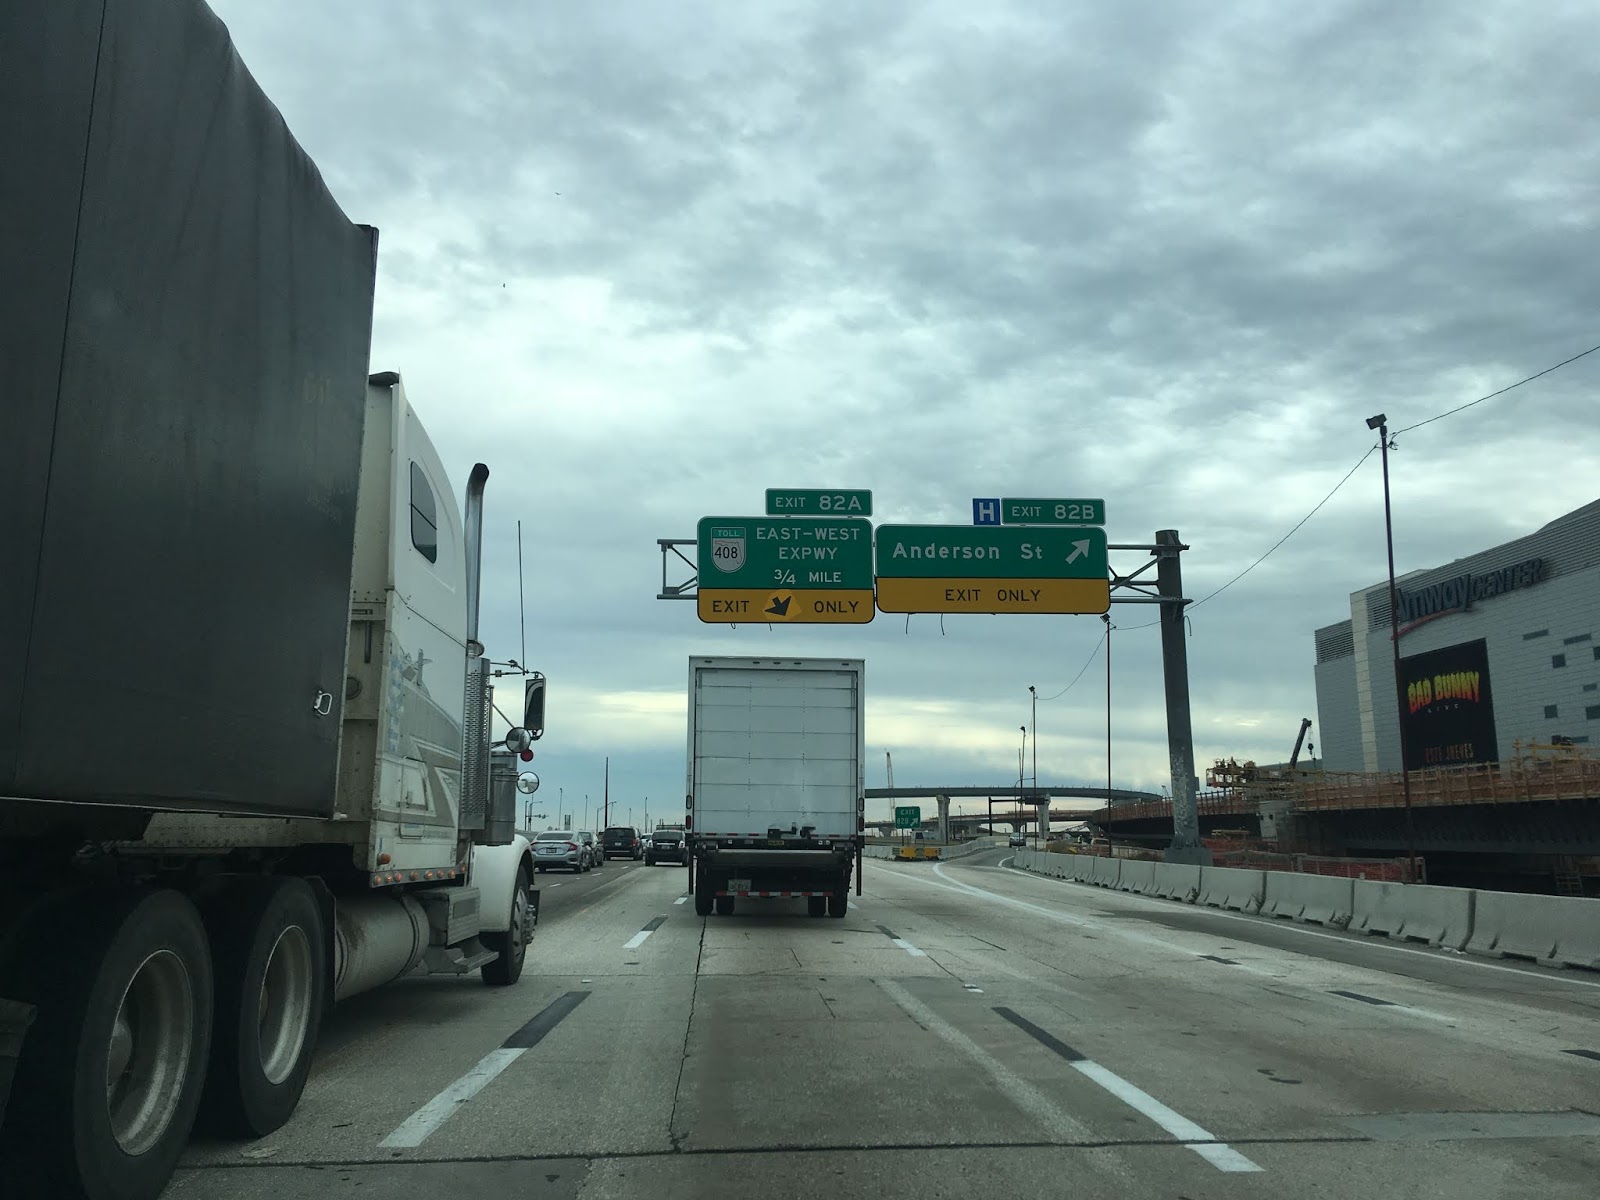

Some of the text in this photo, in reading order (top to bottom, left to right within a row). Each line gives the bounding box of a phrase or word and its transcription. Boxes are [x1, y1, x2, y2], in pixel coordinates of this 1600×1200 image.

[775, 495, 862, 511] EXIT 82A
[978, 502, 995, 521] H
[1011, 504, 1095, 520] EXIT 82B
[717, 529, 740, 537] TOLL
[757, 527, 860, 541] EAST-WEST
[714, 546, 738, 559] 408
[778, 547, 837, 560] EXPWY
[893, 542, 1043, 559] Anderson St
[809, 572, 842, 583] MILE
[1471, 558, 1543, 602] CENTER
[945, 589, 1041, 602] EXIT ONLY
[712, 600, 859, 613] EXIT ONLY
[1408, 671, 1480, 714] BAD BUNNY
